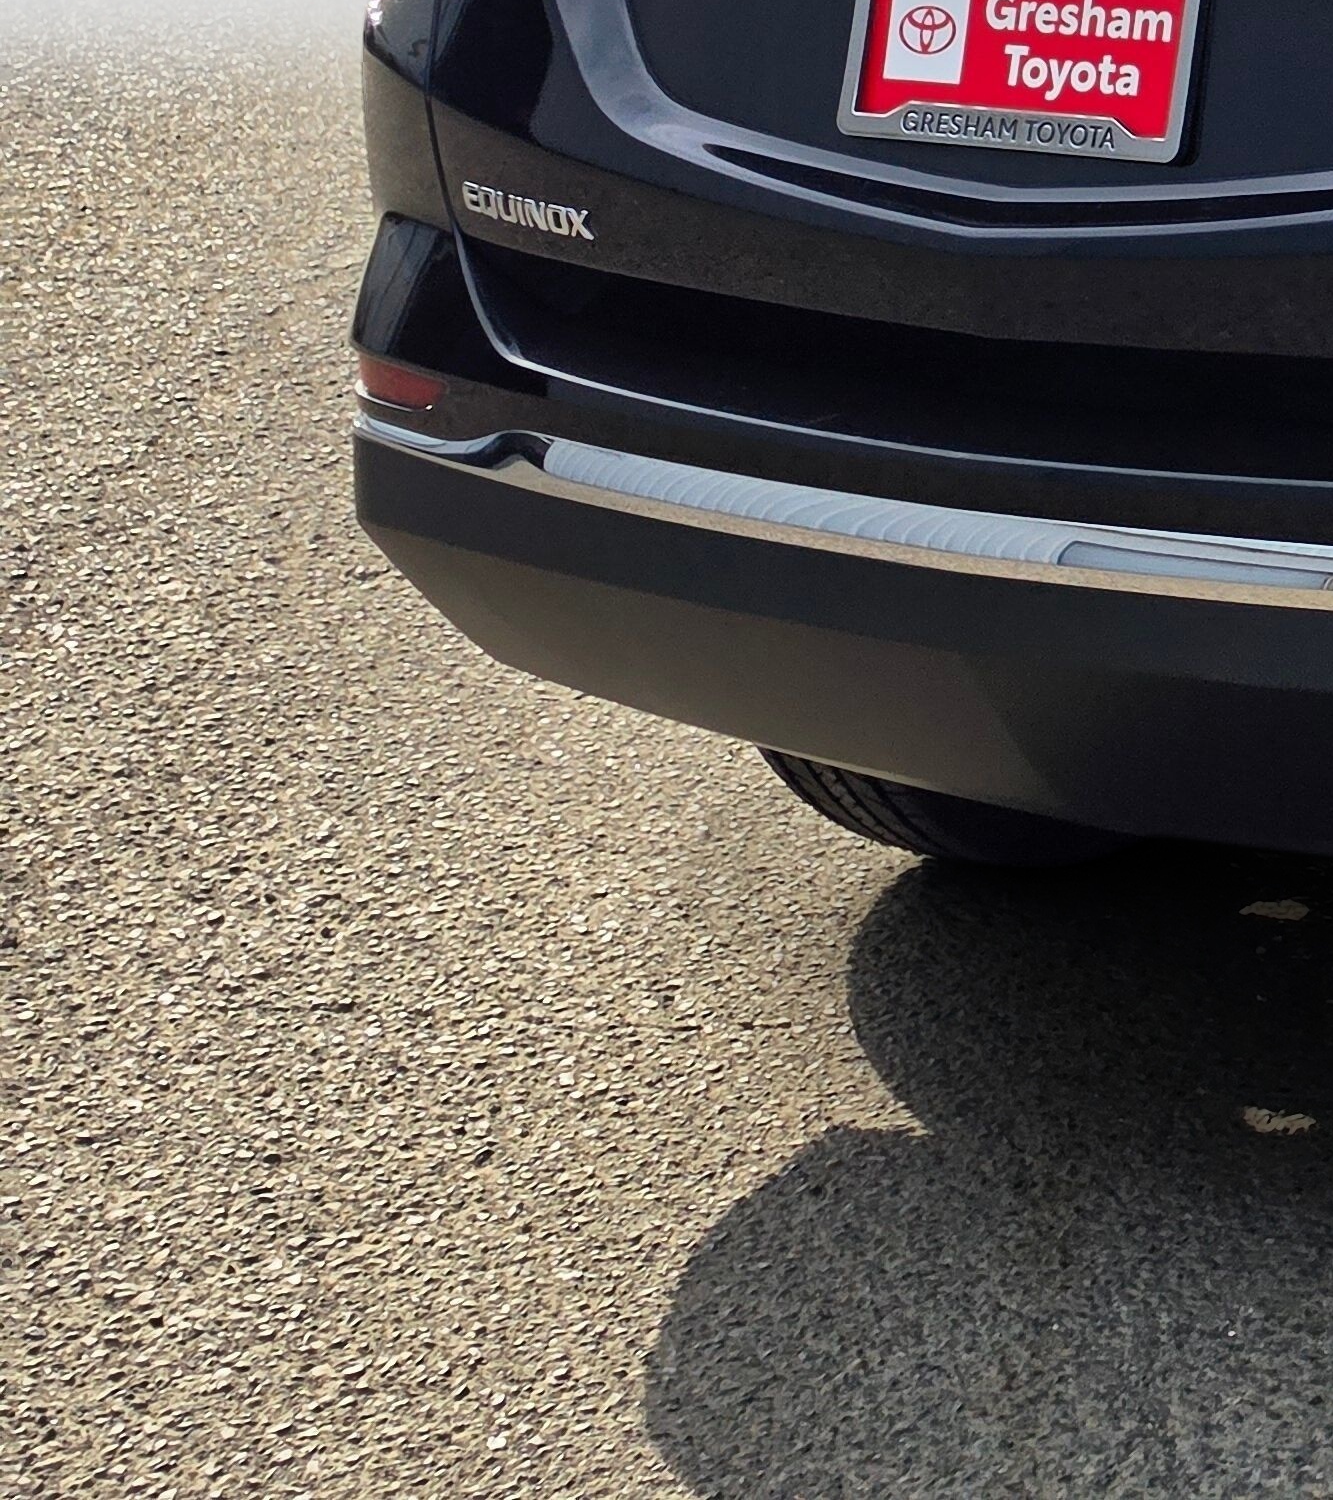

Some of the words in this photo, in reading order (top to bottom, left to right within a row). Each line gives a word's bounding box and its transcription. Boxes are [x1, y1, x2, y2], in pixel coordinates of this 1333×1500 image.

[1004, 44, 1141, 101] Toyota
[902, 110, 1018, 141] GRESHAM
[1026, 120, 1116, 150] TOYOTA
[462, 181, 595, 241] EQUINOX
